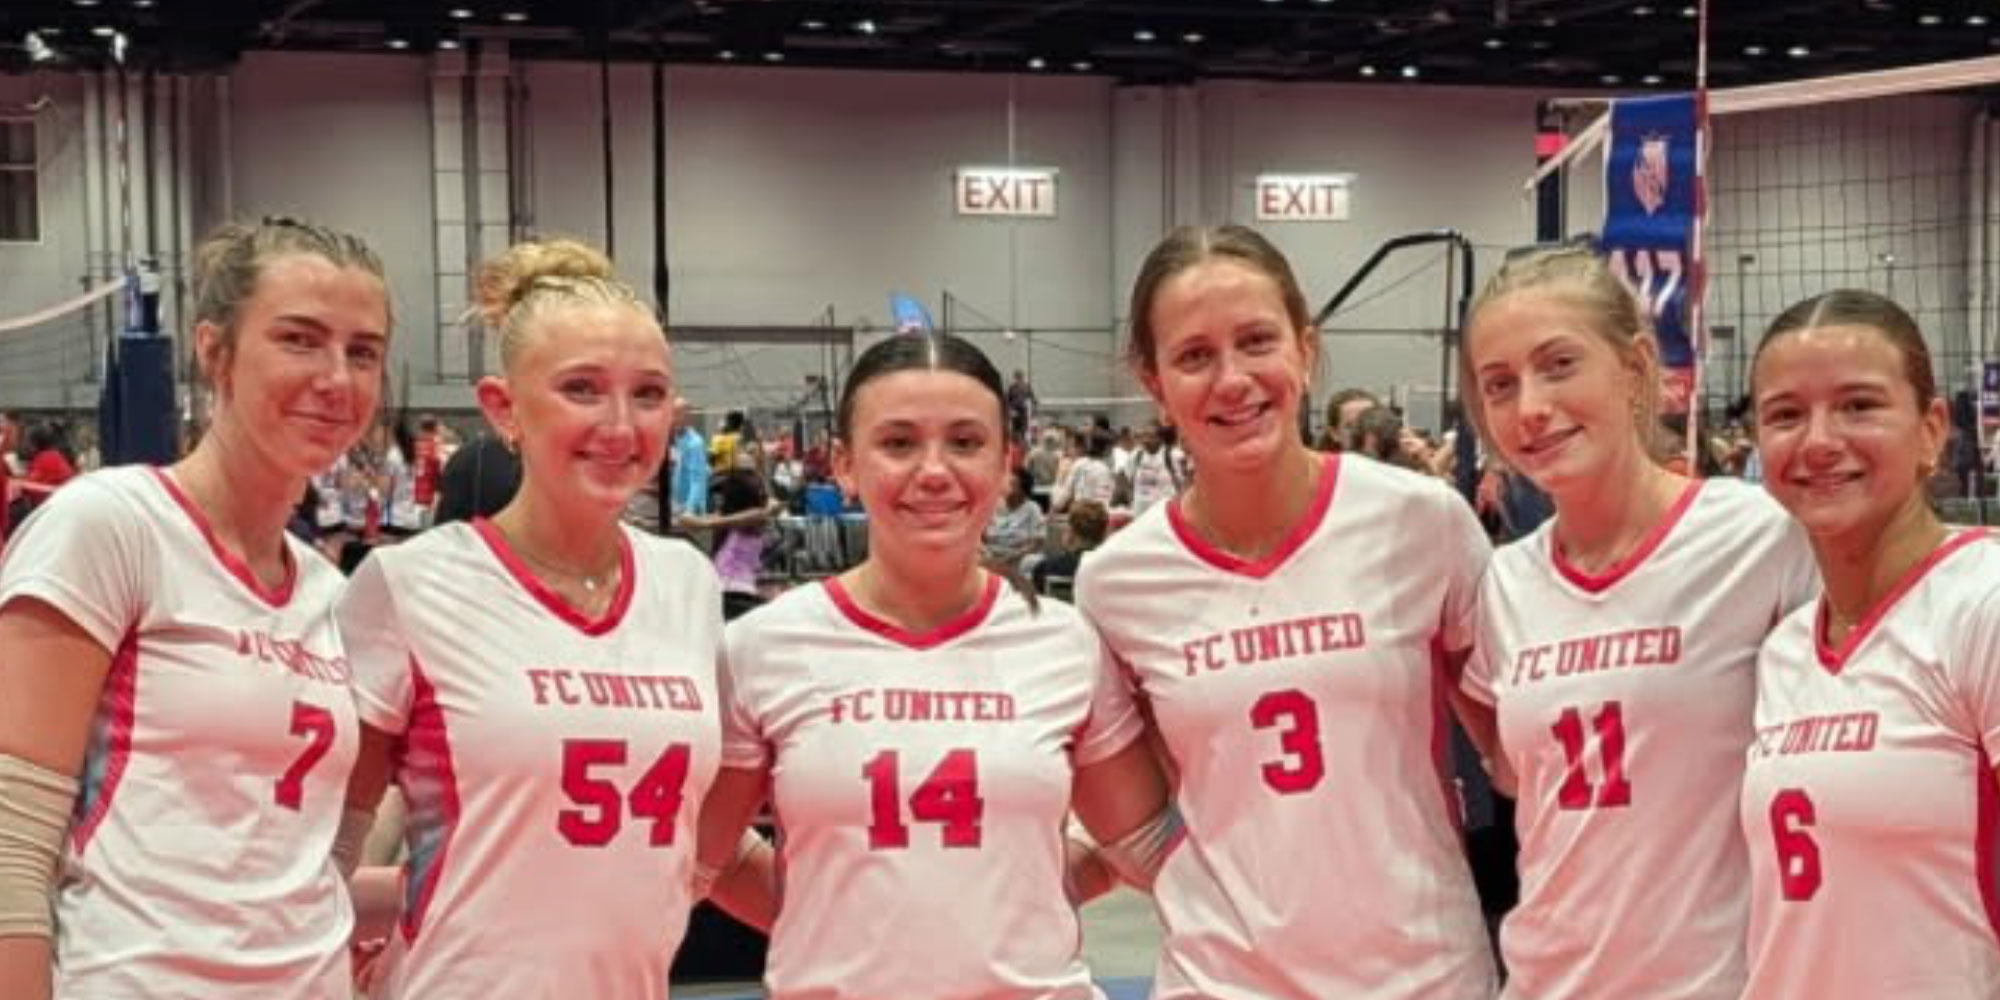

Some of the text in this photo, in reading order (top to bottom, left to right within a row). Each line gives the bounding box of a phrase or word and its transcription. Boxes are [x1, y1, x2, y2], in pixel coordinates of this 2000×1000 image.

[964, 175, 1049, 210] EXIT
[1261, 182, 1345, 216] EXIT
[1184, 613, 1365, 676] FC UNITED
[1512, 626, 1682, 686] FC UNITED
[527, 669, 703, 712] FC UNITED
[831, 689, 1014, 723] FC UNITED
[273, 699, 335, 811] 7
[1250, 690, 1324, 794] 3
[1551, 701, 1631, 810] 11
[1780, 711, 1879, 755] UNITED
[557, 738, 690, 847] 54
[862, 749, 984, 850] 14
[1770, 789, 1822, 901] 6
